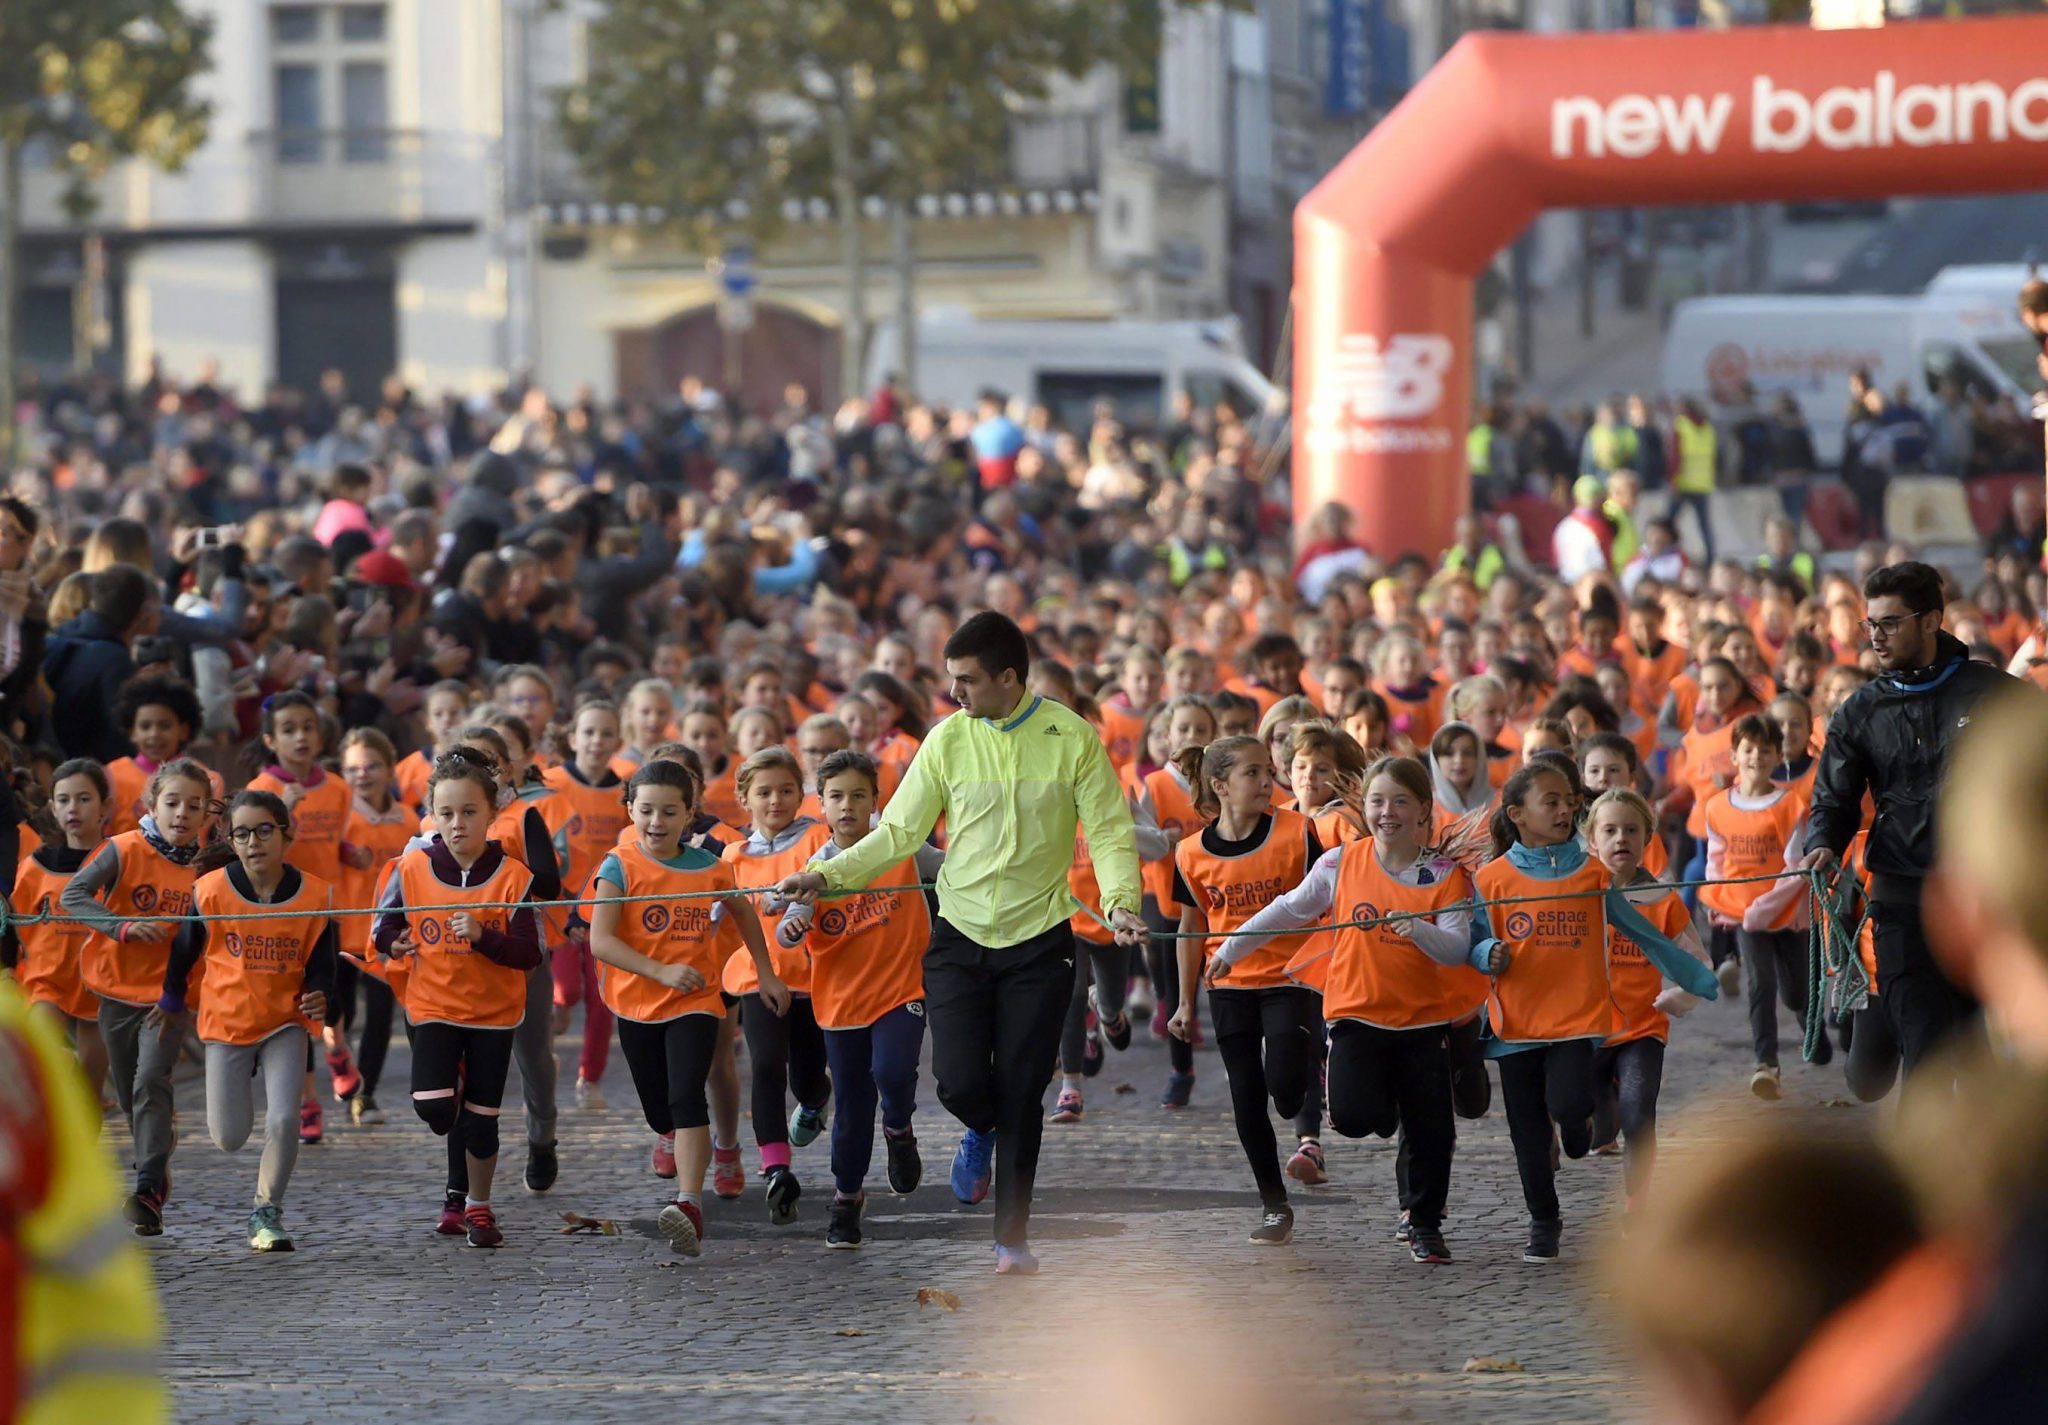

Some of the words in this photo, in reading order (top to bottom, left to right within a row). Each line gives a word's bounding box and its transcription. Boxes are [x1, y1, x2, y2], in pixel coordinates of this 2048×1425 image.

[1551, 92, 1735, 158] new
[1224, 877, 1282, 897] espace
[1536, 910, 1587, 926] espace
[1536, 921, 1590, 937] culturel
[245, 934, 300, 949] espace
[244, 946, 304, 962] culturel
